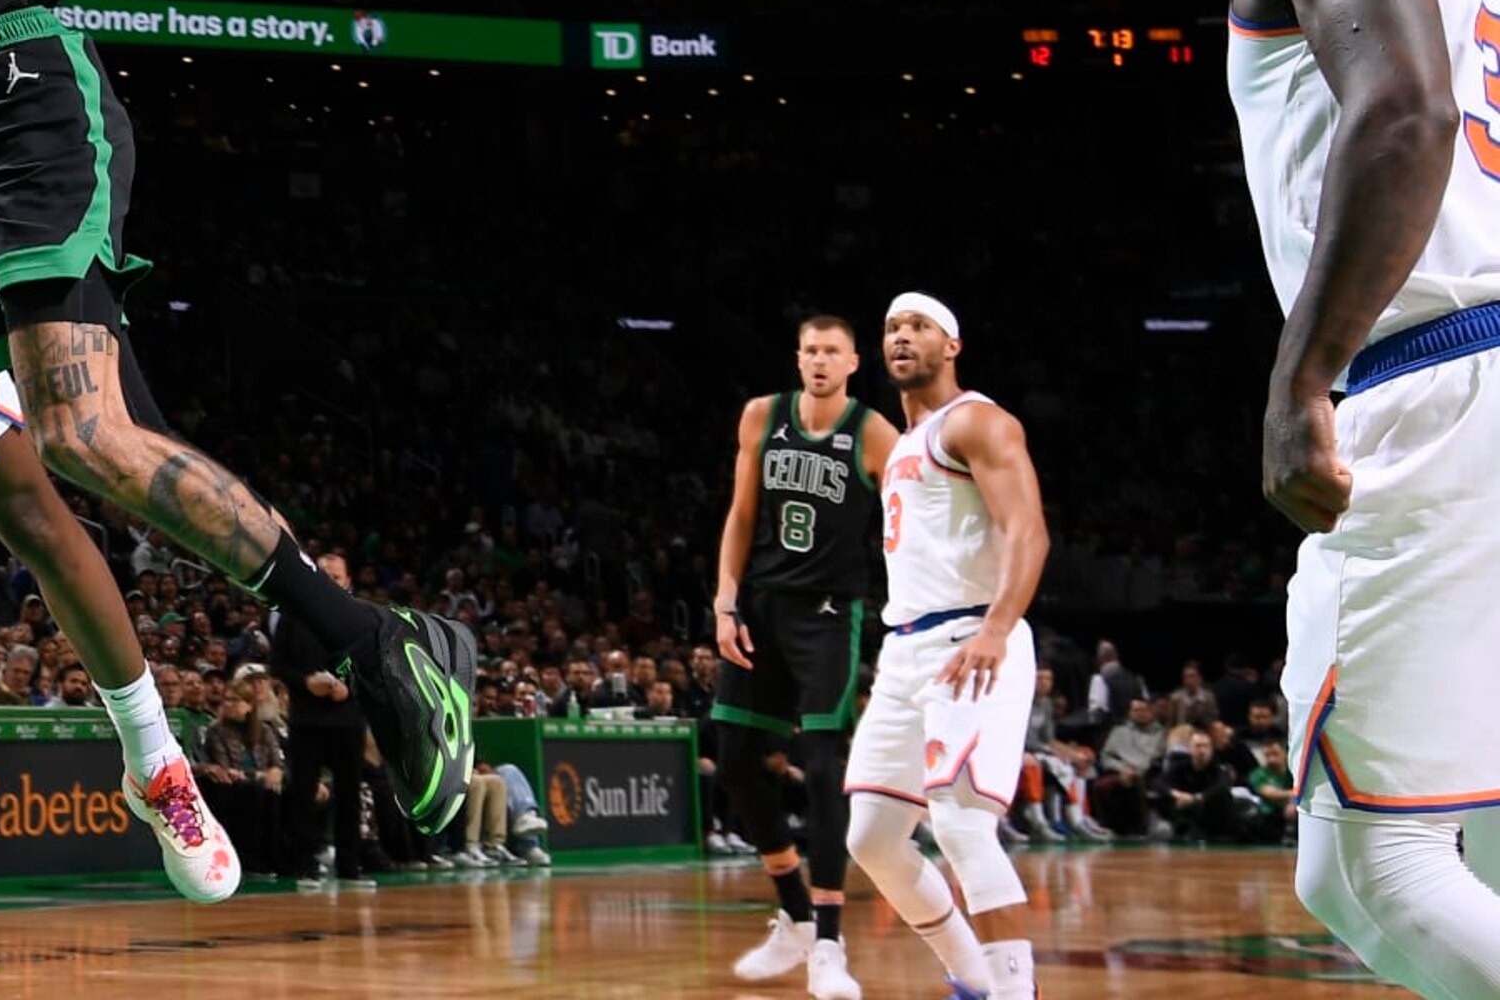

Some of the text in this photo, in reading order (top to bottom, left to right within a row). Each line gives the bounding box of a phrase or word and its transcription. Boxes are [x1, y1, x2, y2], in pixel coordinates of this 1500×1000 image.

[53, 5, 335, 46] stomer has a story.
[594, 31, 717, 60] TD Bank
[1030, 46, 1052, 66] 12
[1170, 46, 1193, 63] 11
[763, 450, 849, 504] CELTICS
[781, 501, 816, 552] 8
